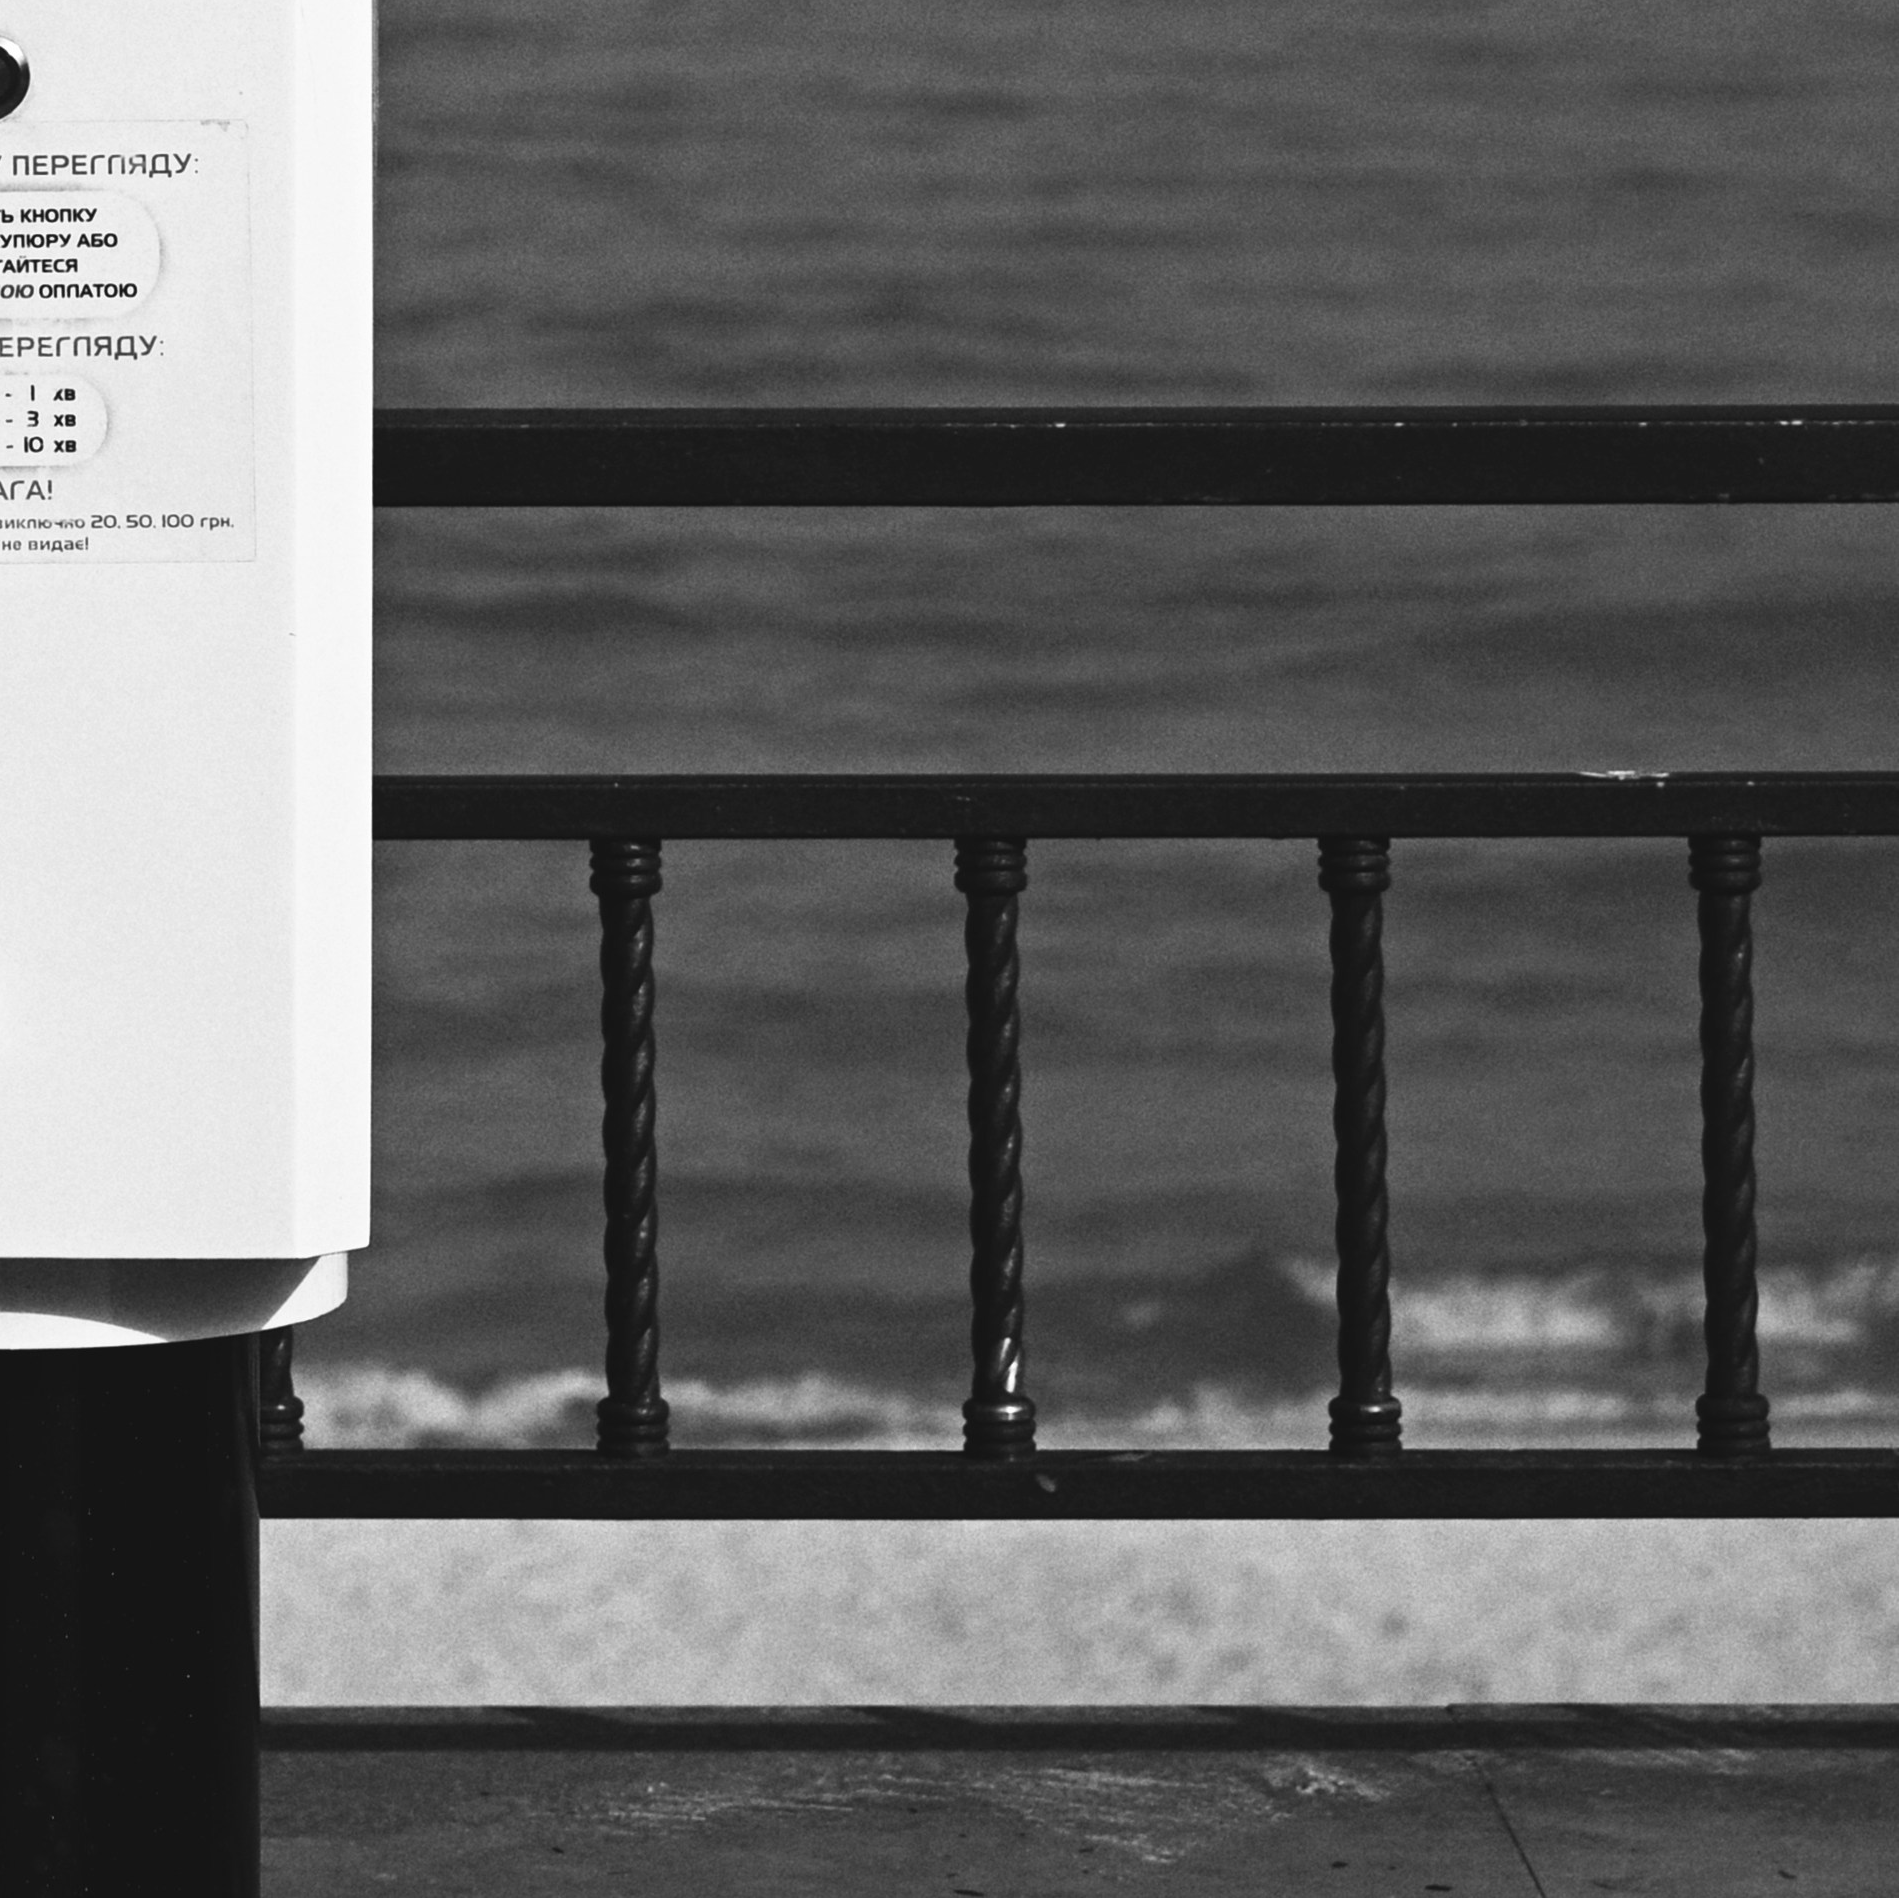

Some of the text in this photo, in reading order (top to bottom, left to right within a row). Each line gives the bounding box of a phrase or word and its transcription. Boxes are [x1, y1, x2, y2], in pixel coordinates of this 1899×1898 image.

[12, 153, 199, 179] ПЕРЕГЛЯДУ:
[20, 207, 98, 224] КНОПКУ
[77, 232, 119, 249] АБО
[38, 282, 138, 299] ОПЛАТОЮ
[53, 387, 76, 402] хв
[26, 410, 40, 428] 3
[53, 413, 77, 428] хв
[24, 435, 44, 454] 10
[53, 439, 77, 454] хв
[161, 513, 195, 529] 100
[199, 516, 235, 531] грн.
[1, 540, 22, 552] не
[27, 536, 89, 553] видає!
